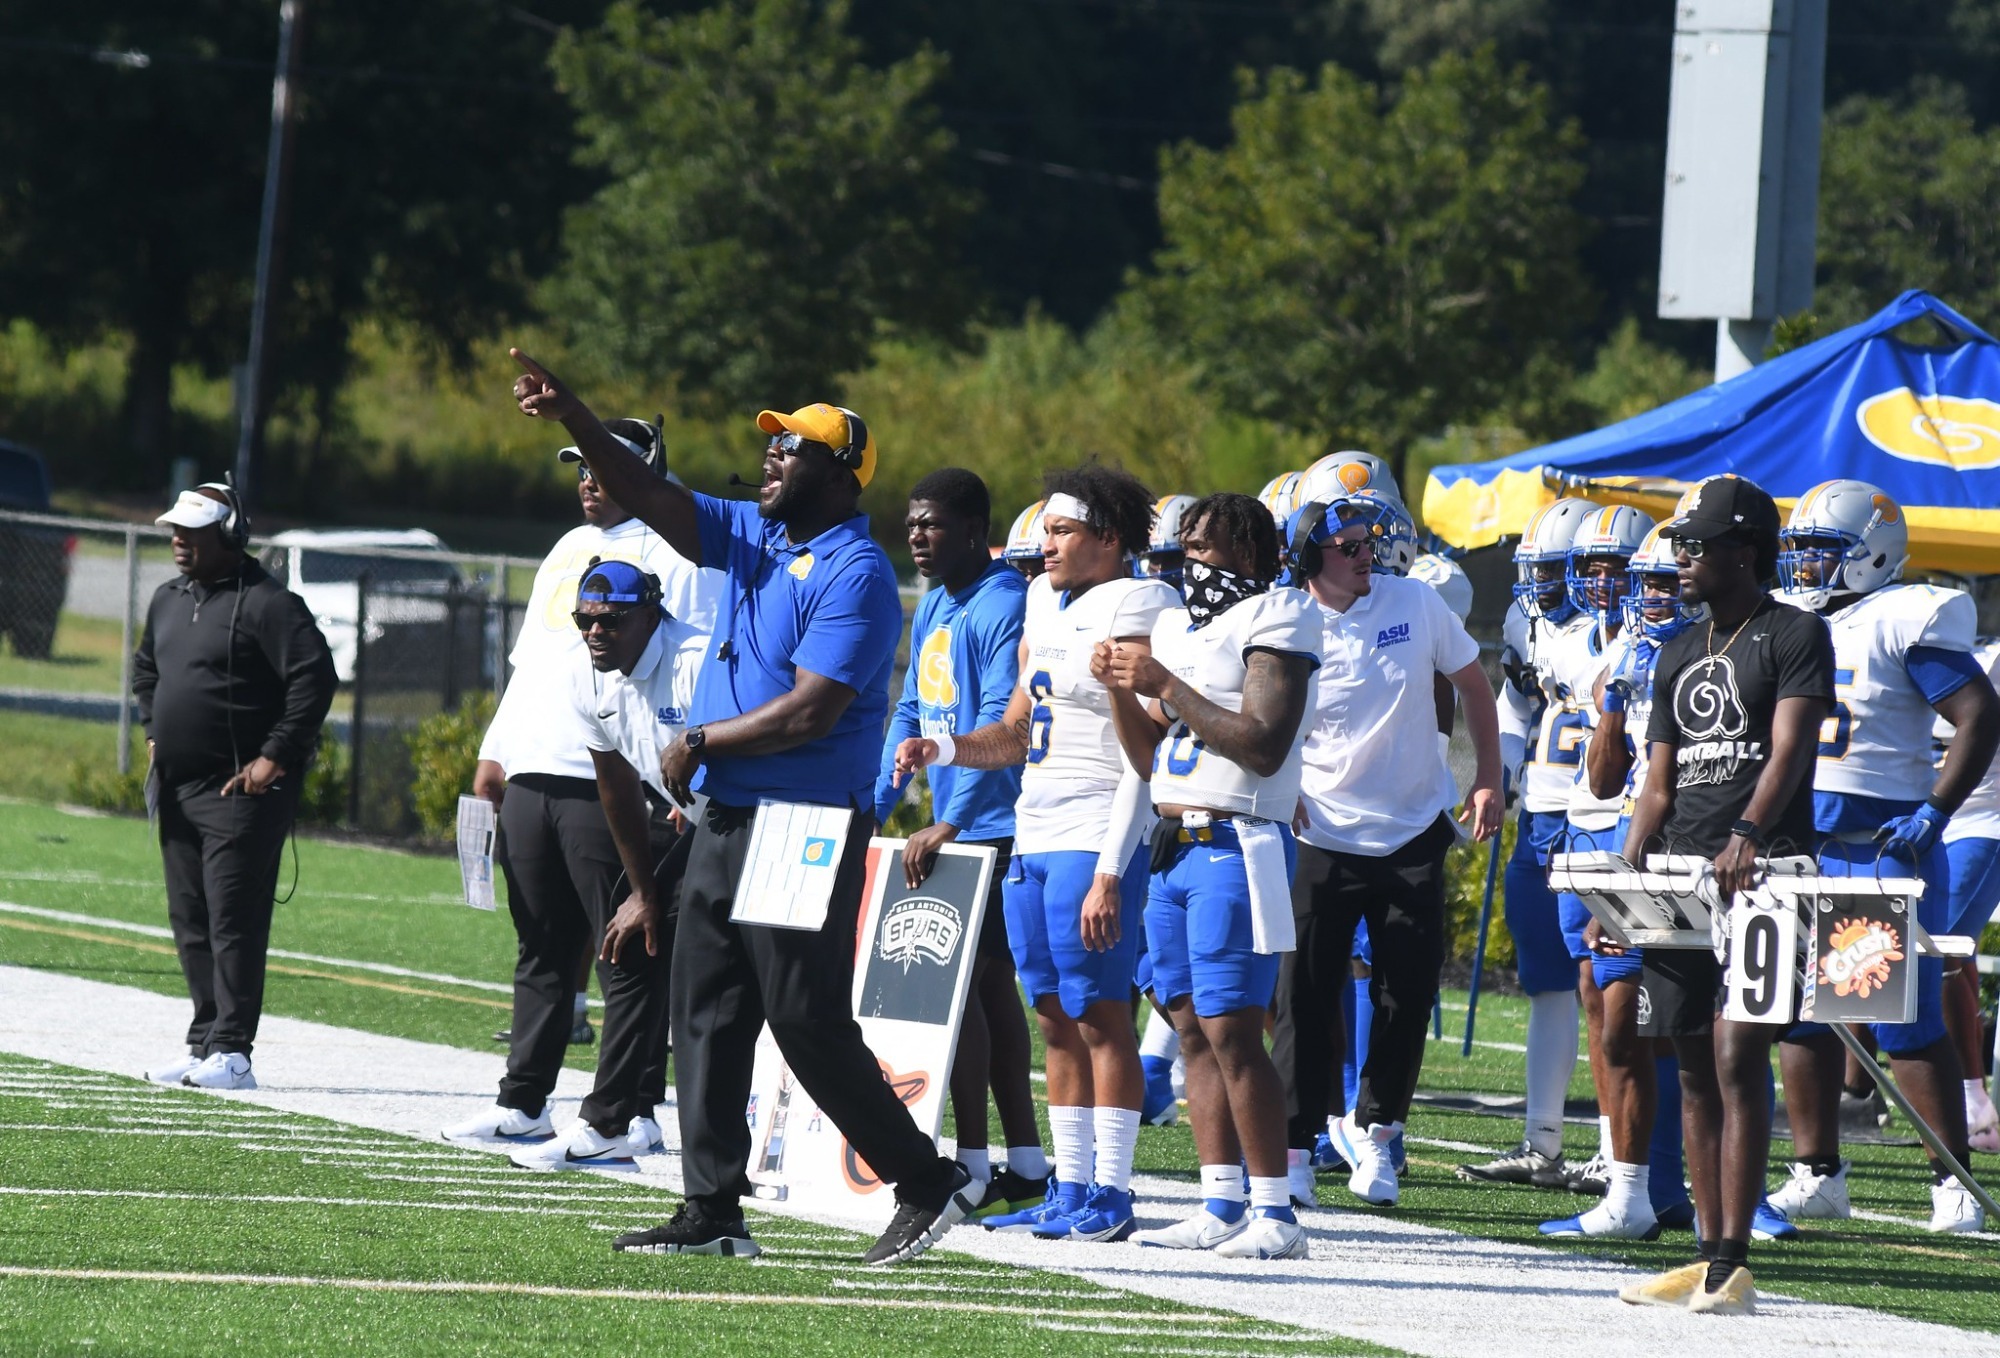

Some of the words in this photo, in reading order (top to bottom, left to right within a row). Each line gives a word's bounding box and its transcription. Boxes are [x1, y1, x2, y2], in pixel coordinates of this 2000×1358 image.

[1377, 623, 1409, 644] ASU
[1377, 636, 1411, 649] FOOTBALL
[658, 707, 682, 719] ASU
[1028, 668, 1055, 768] 6
[896, 903, 915, 913] SAN
[917, 902, 954, 918] ANTONIO
[890, 917, 951, 948] SPURS
[1743, 914, 1779, 1016] 9
[1826, 927, 1893, 983] Crush
